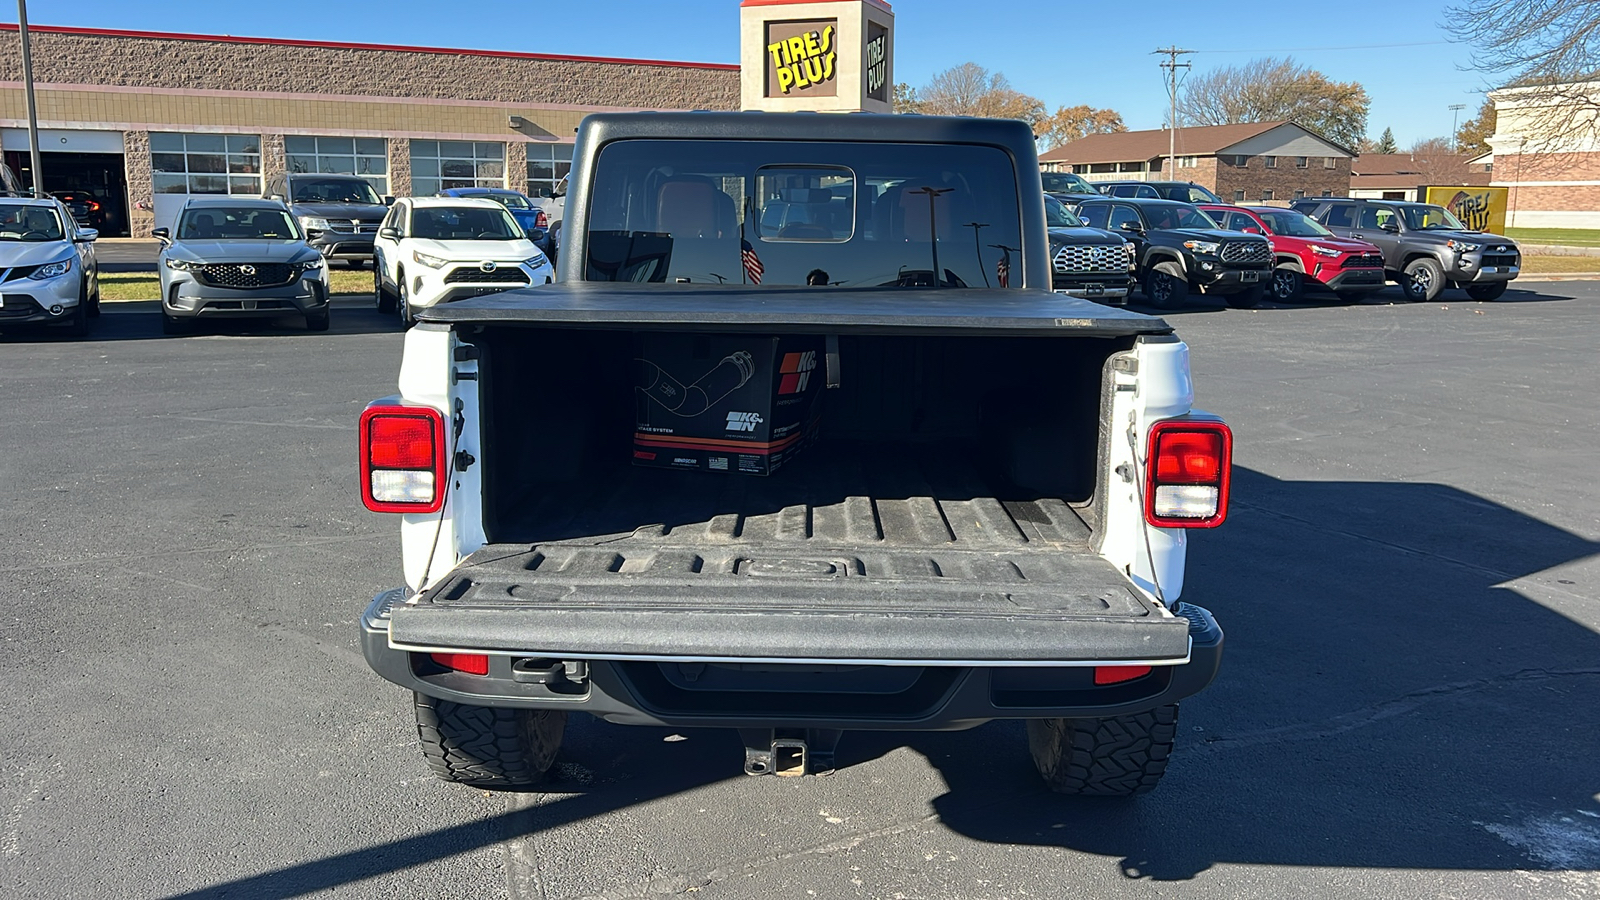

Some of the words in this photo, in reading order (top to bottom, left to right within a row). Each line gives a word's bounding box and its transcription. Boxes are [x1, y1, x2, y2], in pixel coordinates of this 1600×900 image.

[768, 26, 834, 68] TIRES
[867, 36, 885, 68] TIRES
[777, 51, 836, 94] PLUS
[868, 61, 885, 94] PLUS
[1456, 192, 1490, 220] TIRES
